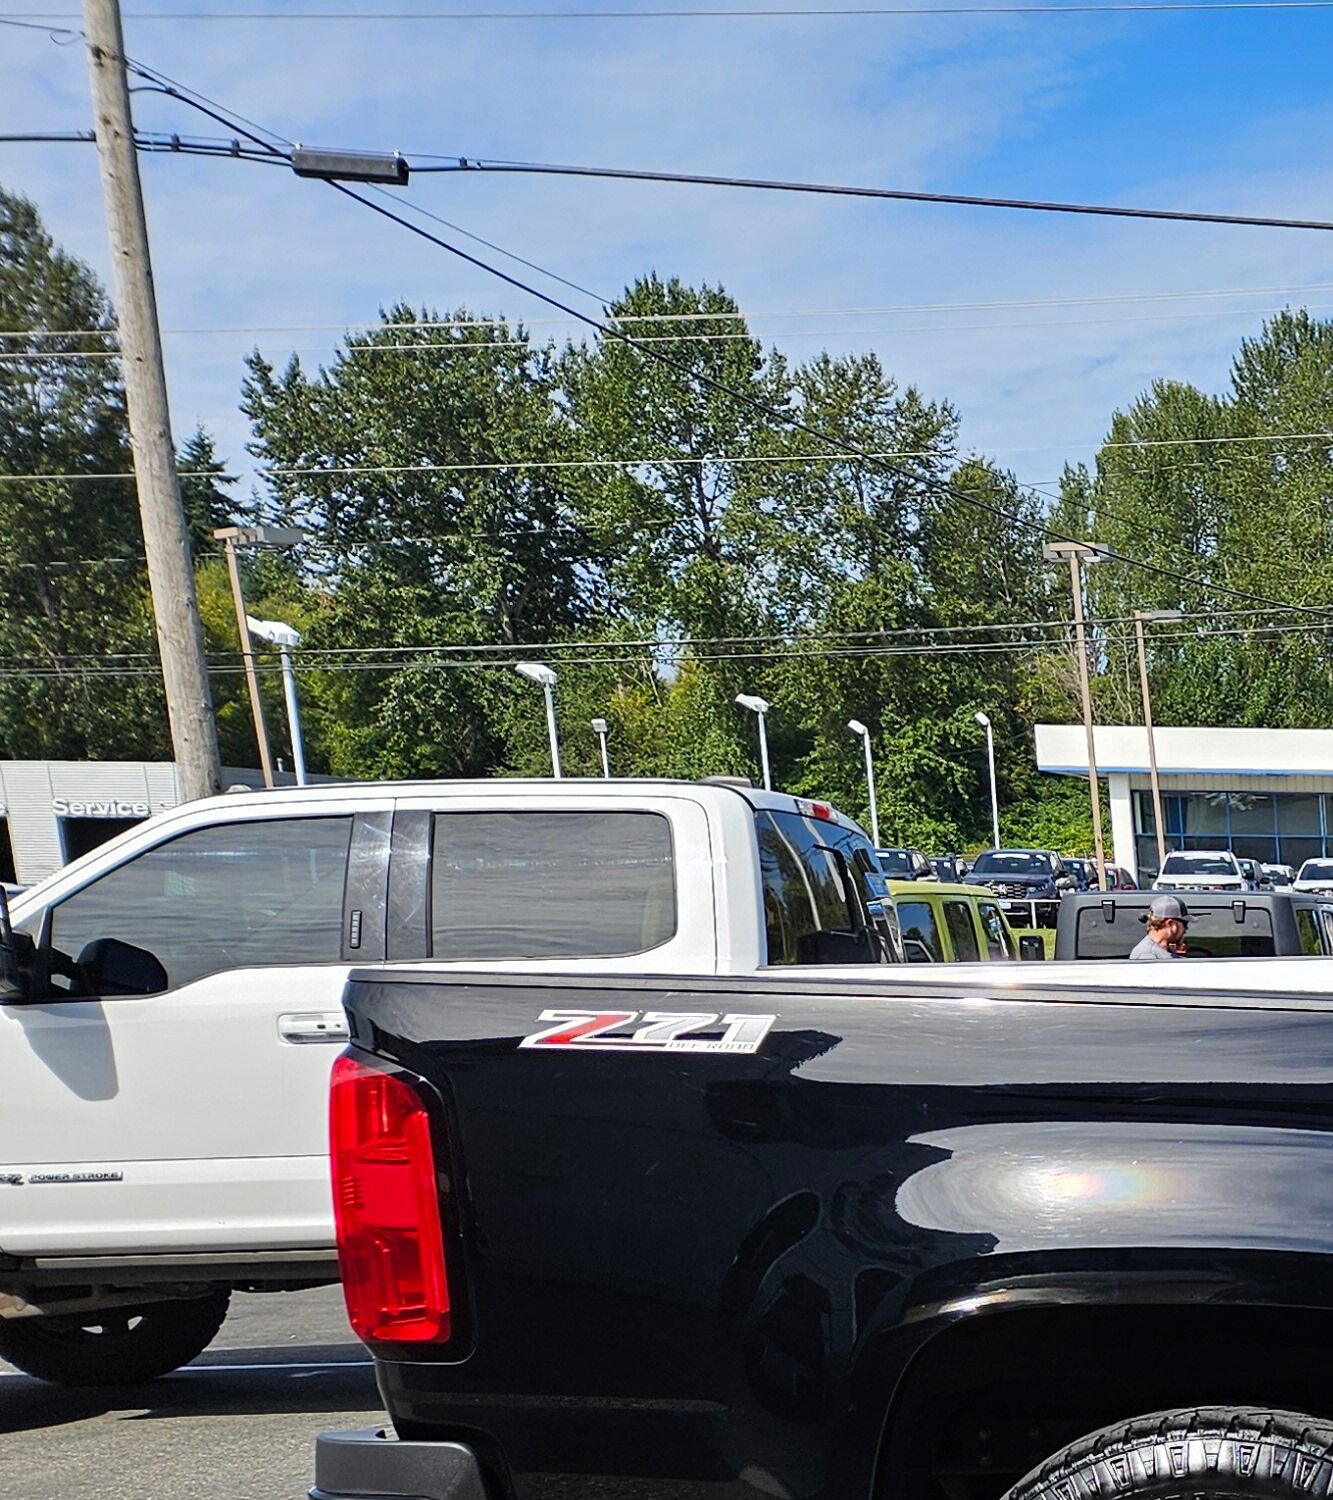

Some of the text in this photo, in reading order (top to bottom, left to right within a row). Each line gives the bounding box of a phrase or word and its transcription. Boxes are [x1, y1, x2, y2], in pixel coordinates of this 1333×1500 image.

[52, 799, 149, 816] Service
[518, 1009, 776, 1053] Z71
[669, 1041, 701, 1049] OFF
[73, 1171, 118, 1180] STROKE
